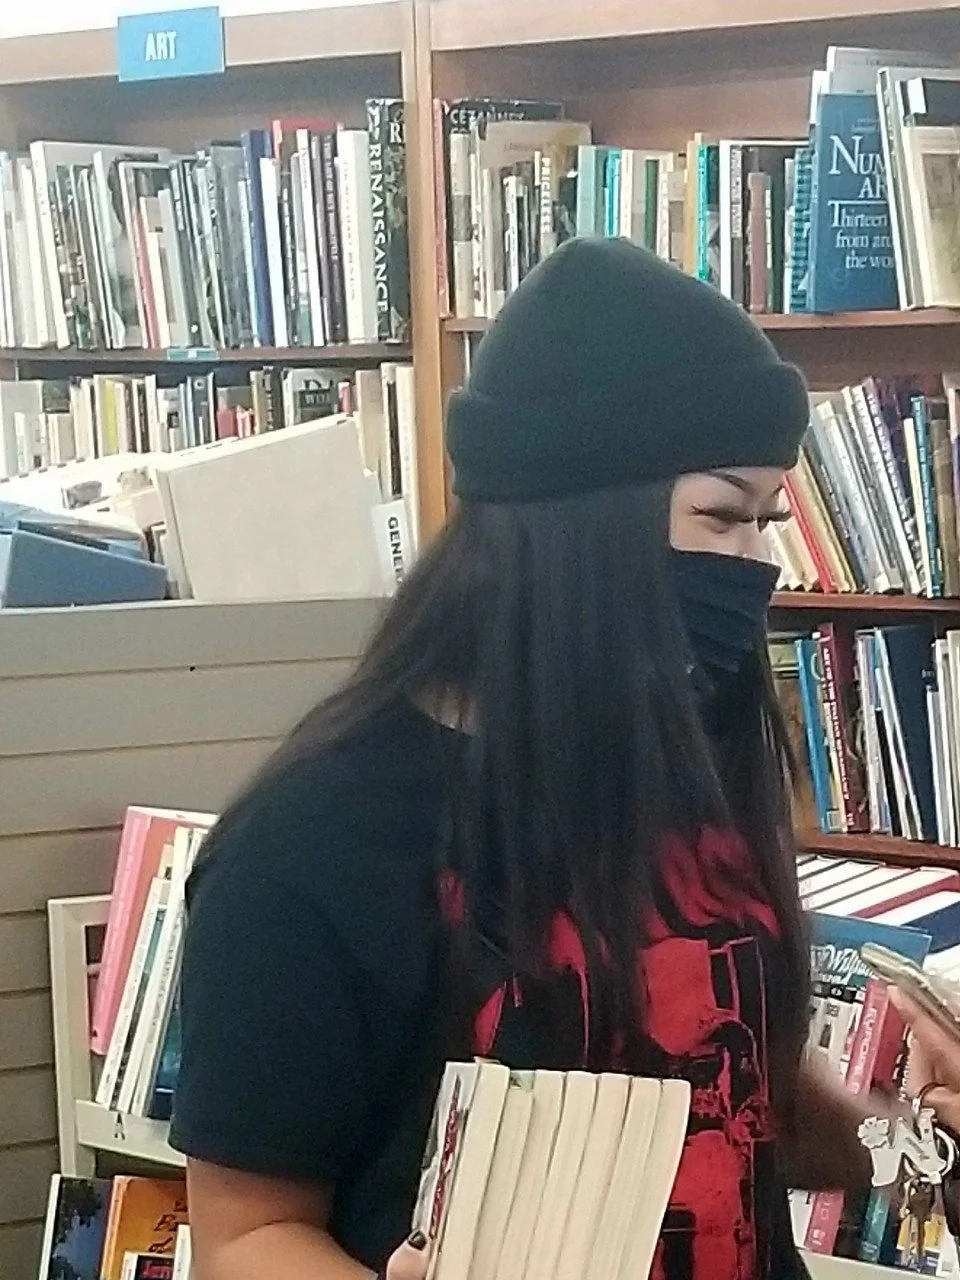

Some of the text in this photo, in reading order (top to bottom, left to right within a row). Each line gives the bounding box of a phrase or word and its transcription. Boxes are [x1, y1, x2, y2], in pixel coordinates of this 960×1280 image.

[145, 31, 178, 61] ART
[369, 143, 389, 313] RENAISSANCE
[828, 200, 888, 228] Thirteen
[835, 232, 870, 249] from
[845, 254, 866, 269] the
